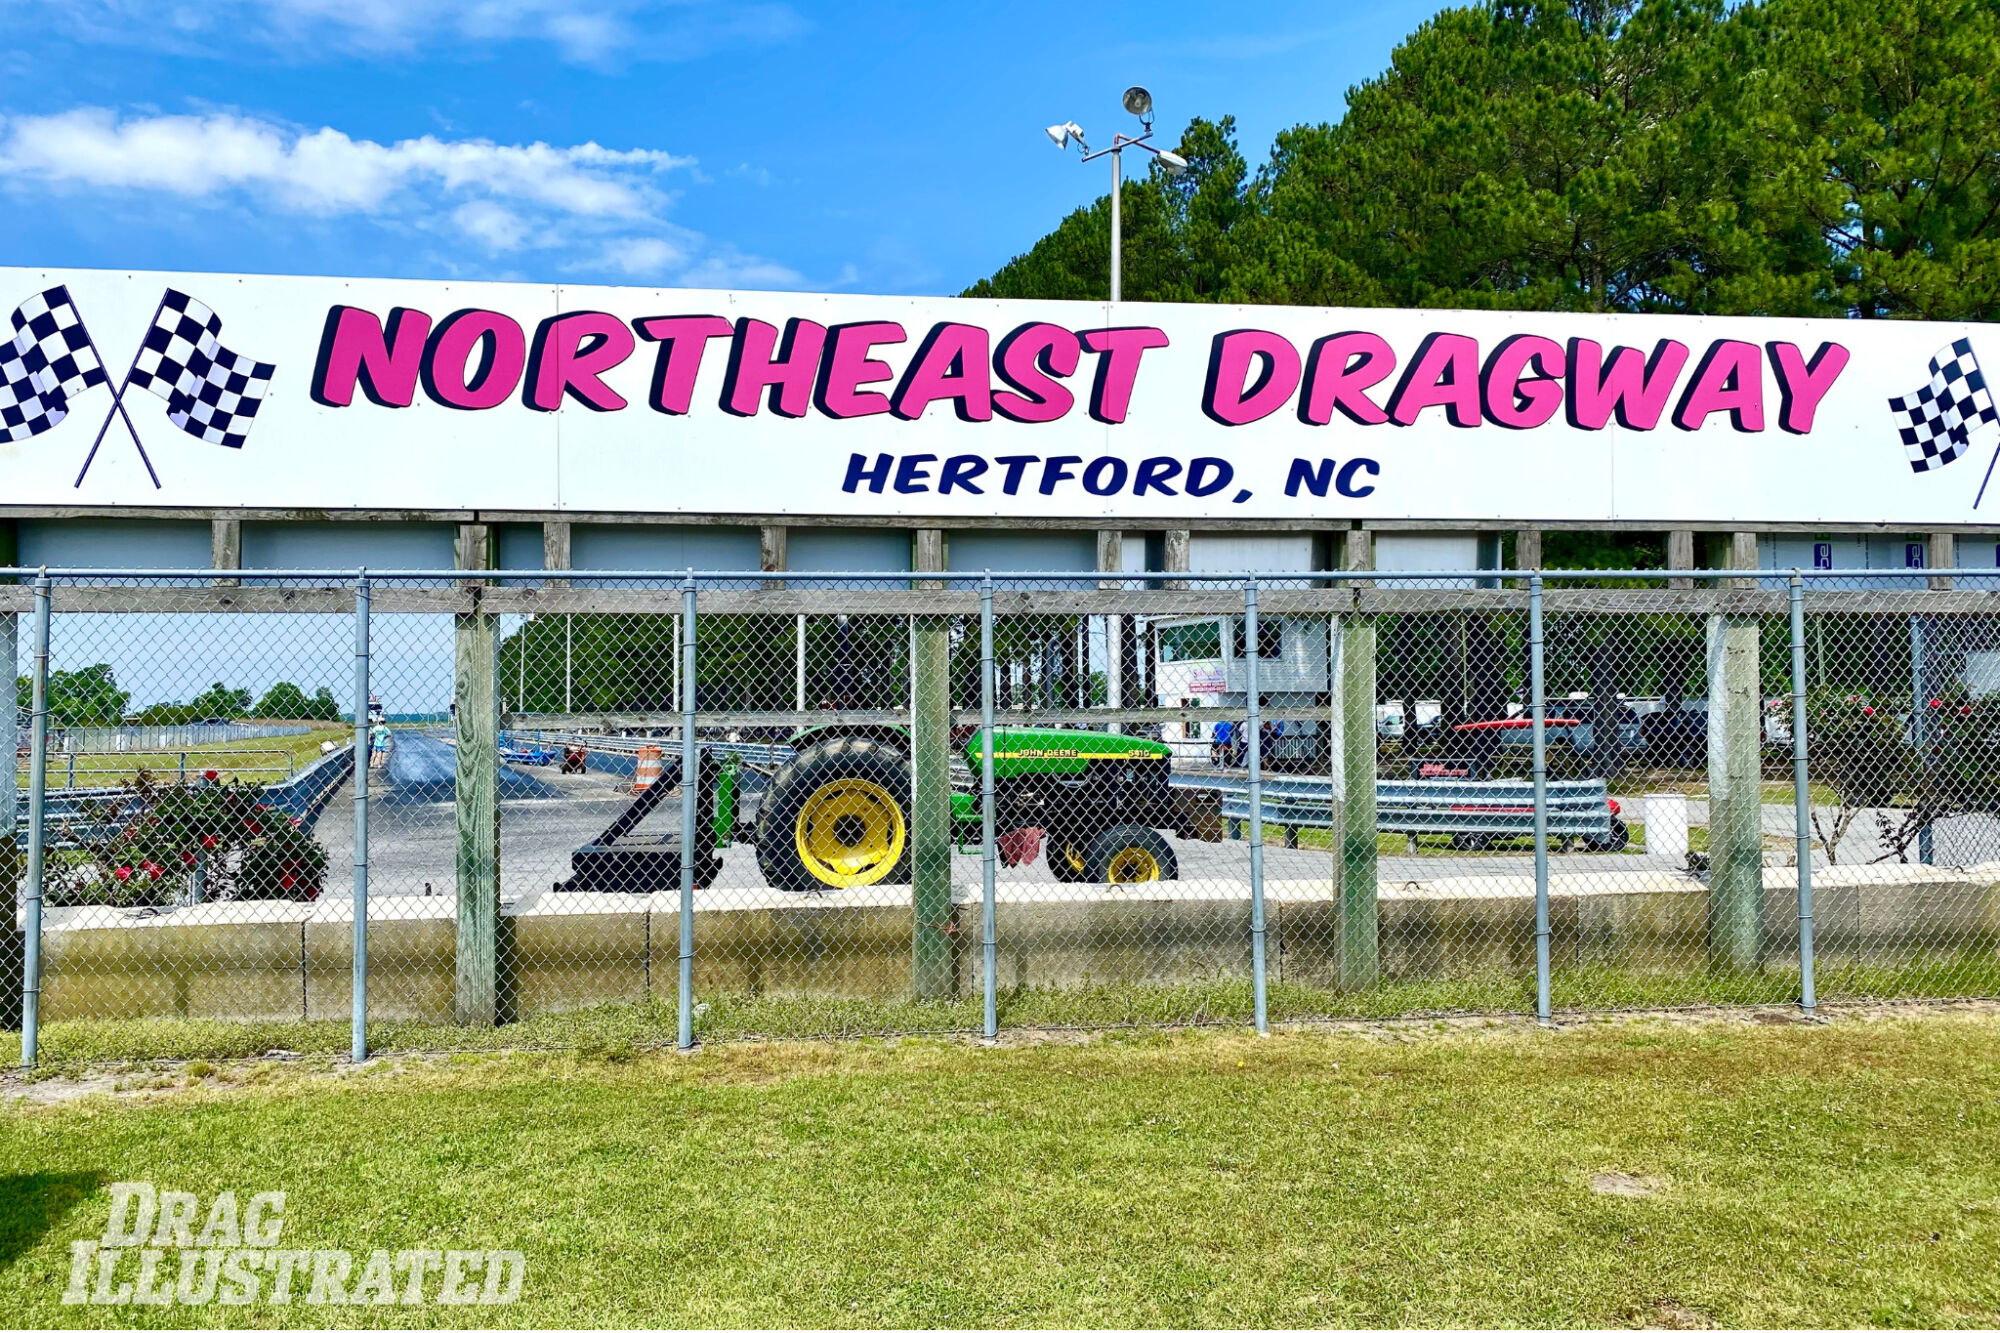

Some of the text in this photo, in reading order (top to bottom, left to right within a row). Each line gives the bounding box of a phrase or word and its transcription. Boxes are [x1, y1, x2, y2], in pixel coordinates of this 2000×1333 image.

[310, 304, 1850, 436] NORTHEAST DRAGWAY
[842, 453, 1380, 503] HERTFORD, NC
[1018, 749, 1078, 757] JOHN DEERE
